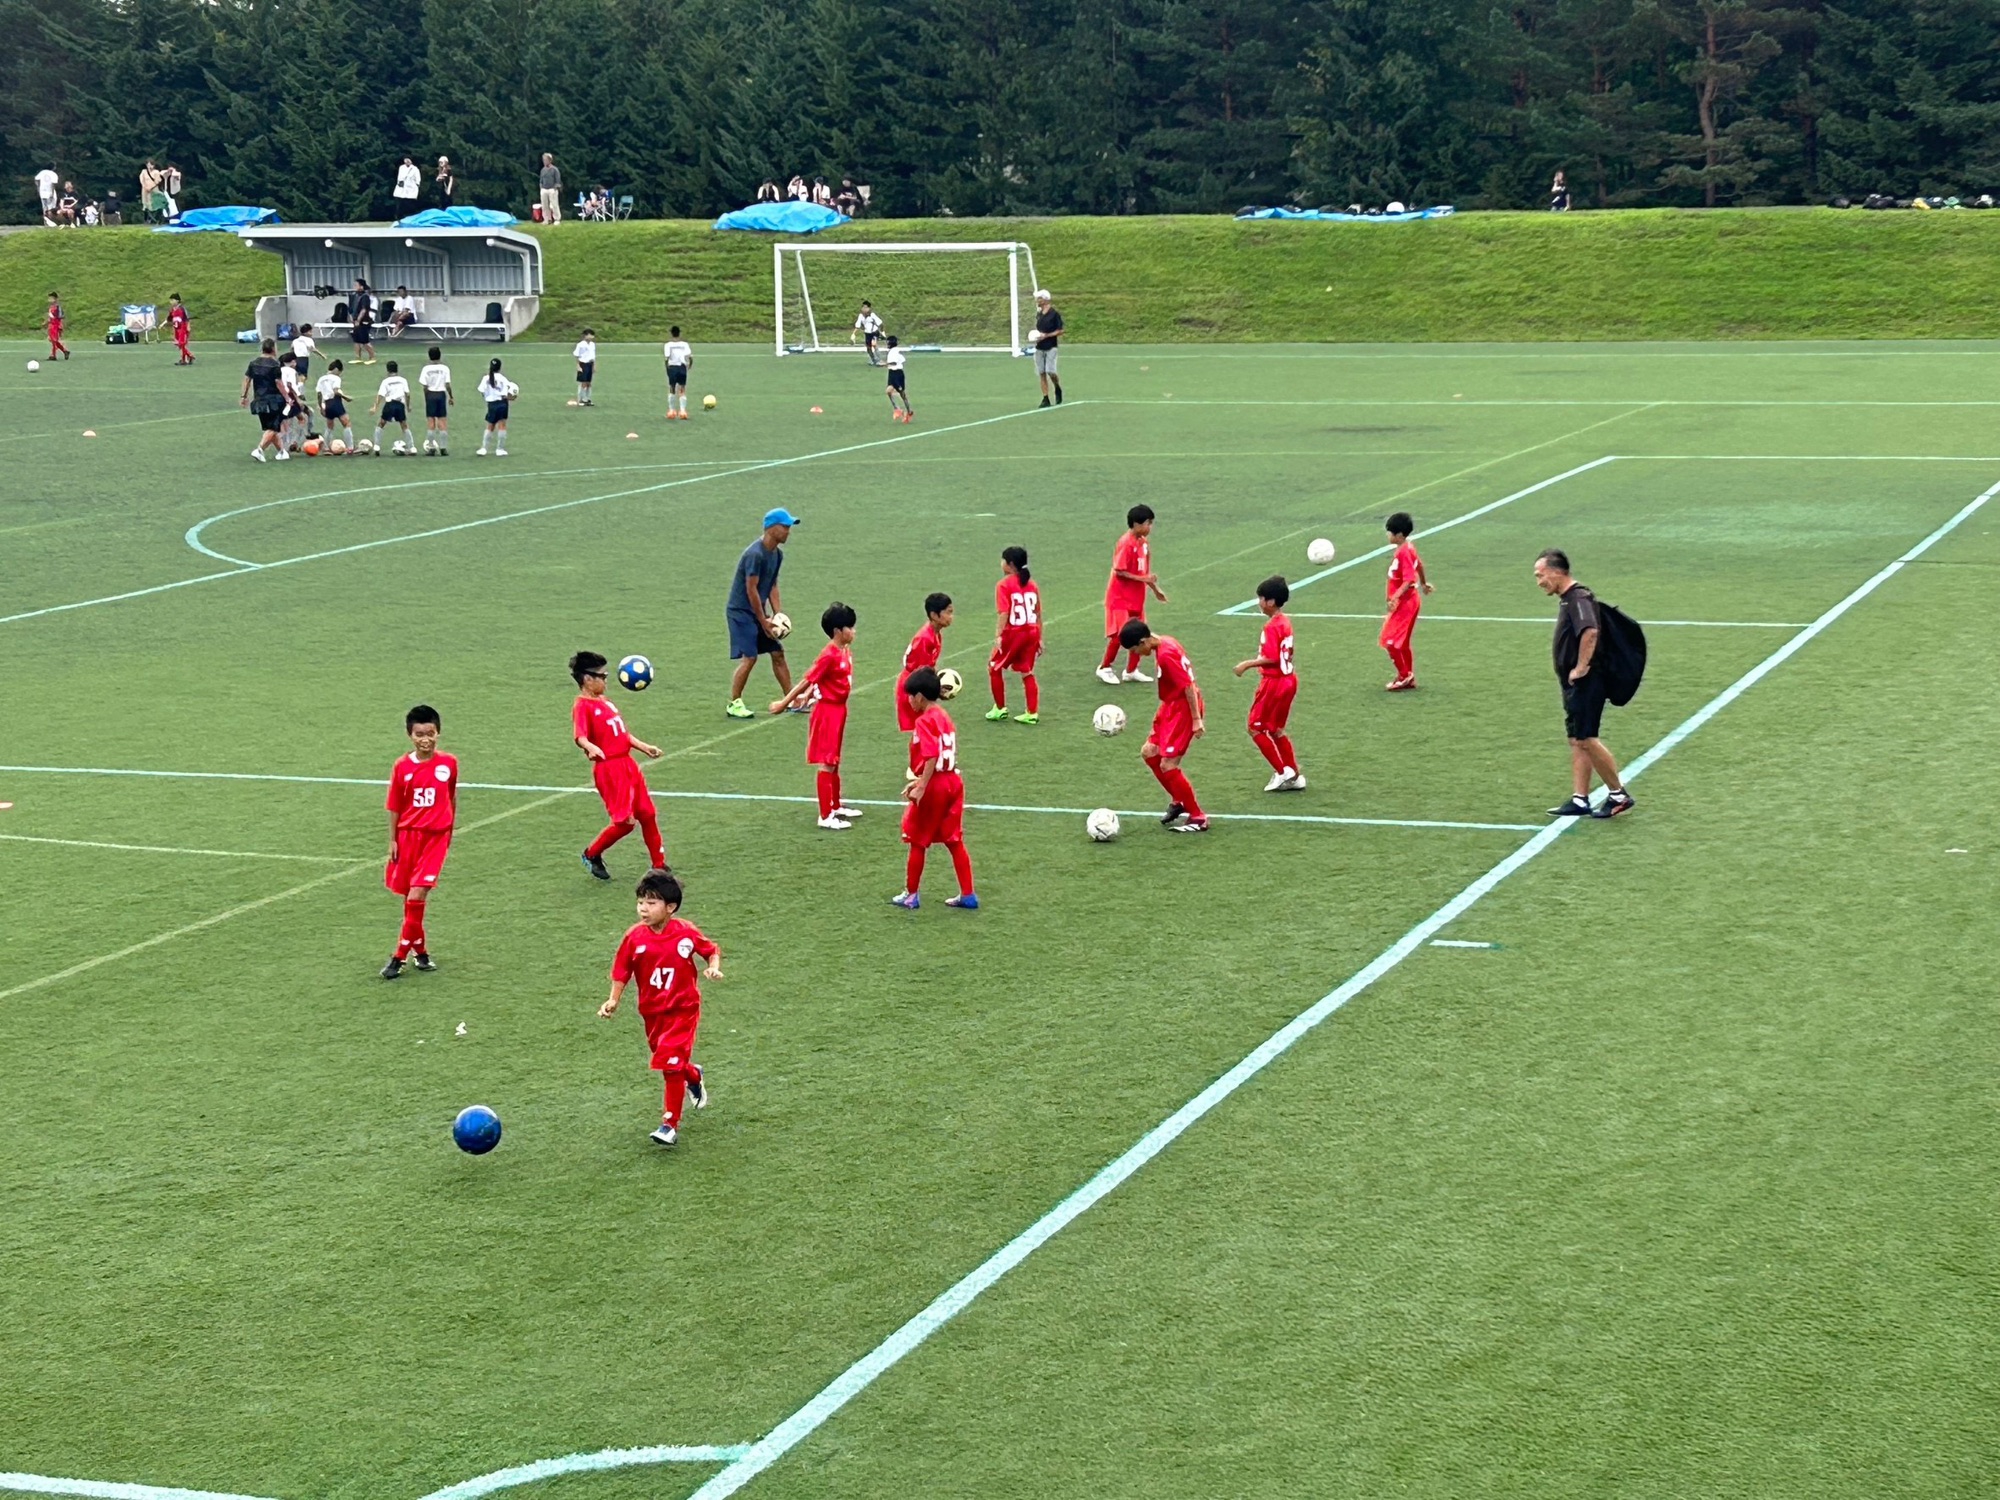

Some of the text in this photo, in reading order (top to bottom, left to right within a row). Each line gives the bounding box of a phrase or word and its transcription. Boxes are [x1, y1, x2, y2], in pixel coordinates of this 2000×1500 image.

[606, 715, 627, 737] 77
[413, 787, 436, 808] 58
[649, 967, 675, 990] 47
